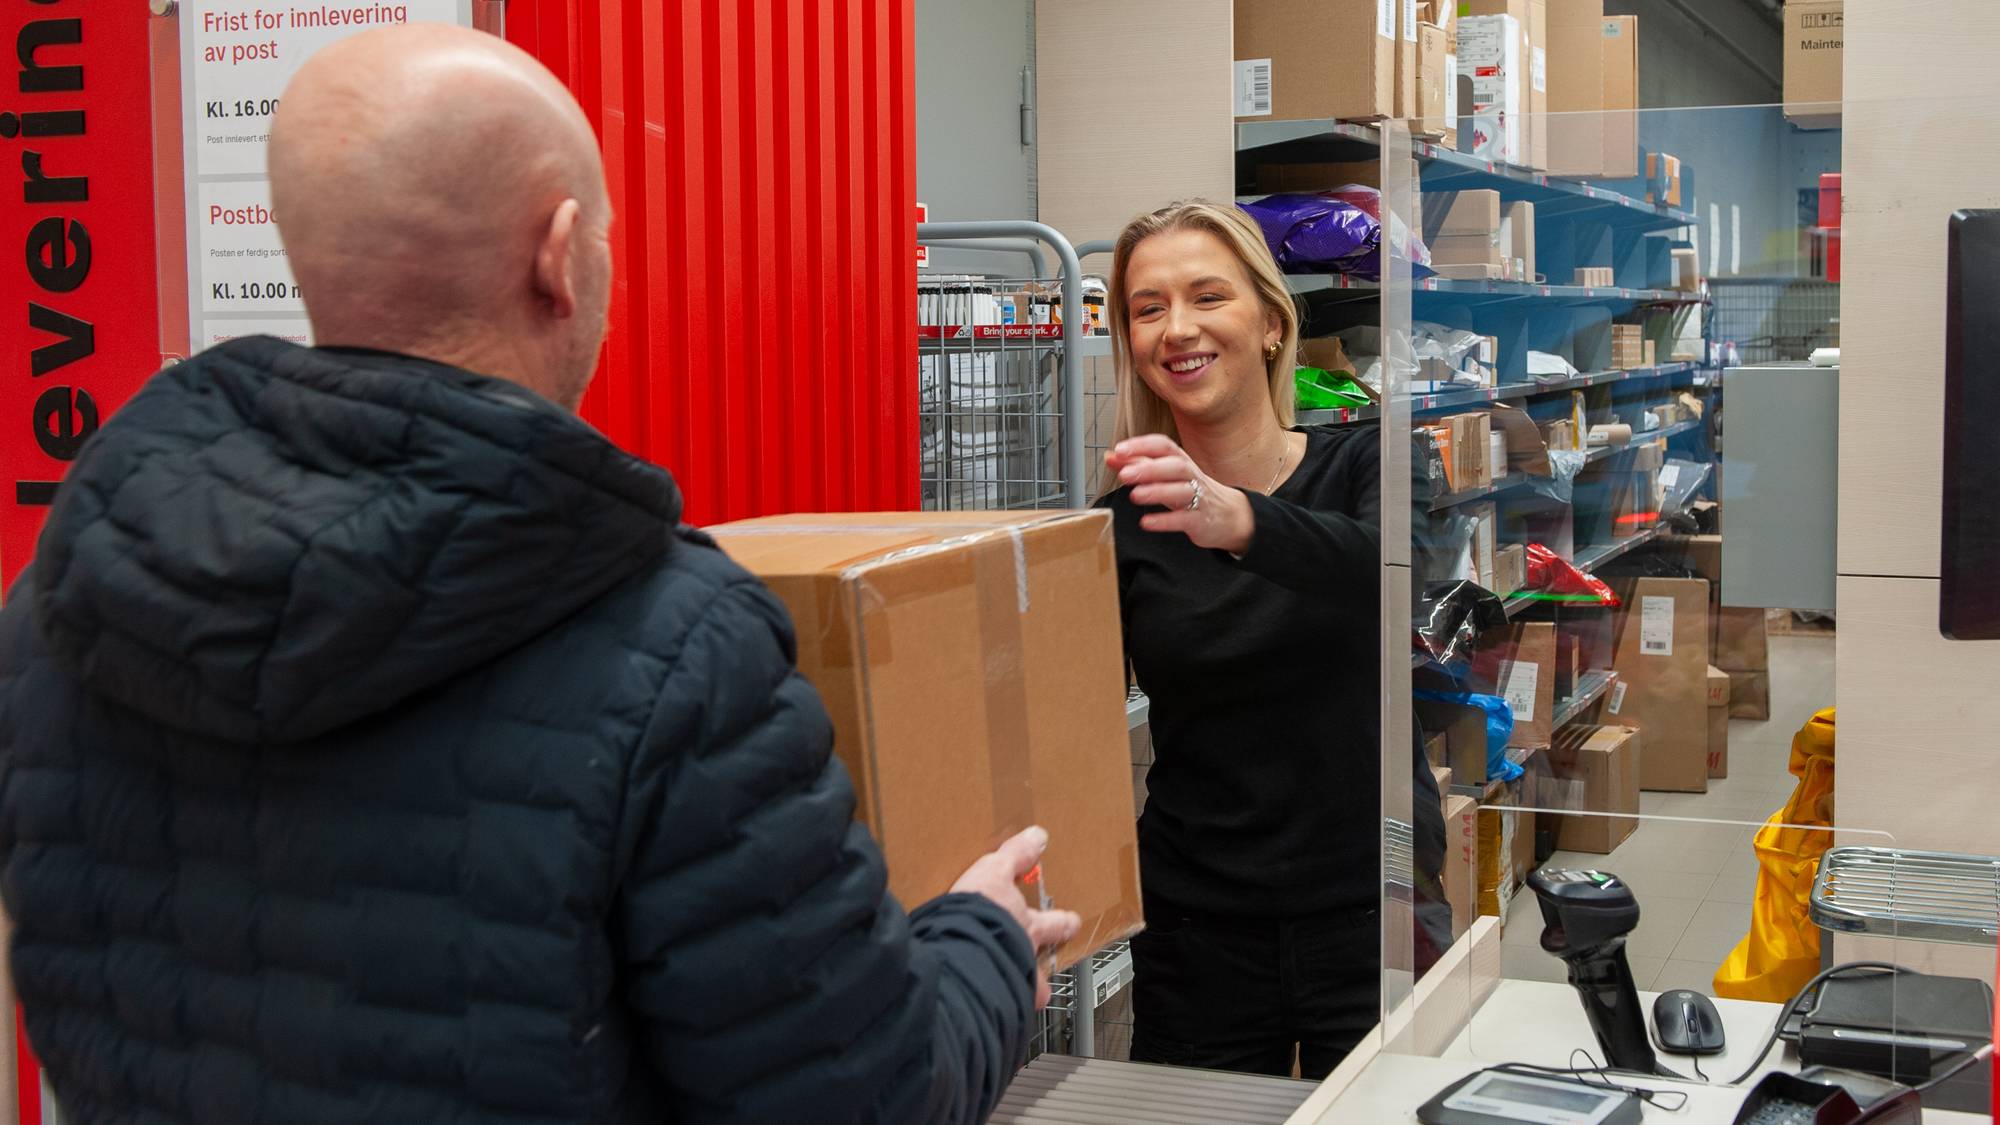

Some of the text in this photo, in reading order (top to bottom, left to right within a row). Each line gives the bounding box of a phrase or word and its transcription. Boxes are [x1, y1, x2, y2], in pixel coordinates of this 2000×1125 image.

[204, 3, 407, 32] Frist for innlevering
[204, 40, 278, 65] av post
[206, 101, 229, 118] Kl.
[207, 135, 224, 144] Post
[225, 134, 257, 143] innlevert
[210, 248, 236, 257] Posten
[237, 249, 245, 257] er
[246, 248, 269, 258] ferdig
[213, 283, 235, 299] Kl.
[240, 282, 287, 299] 10.00
[1005, 328, 1023, 336] your
